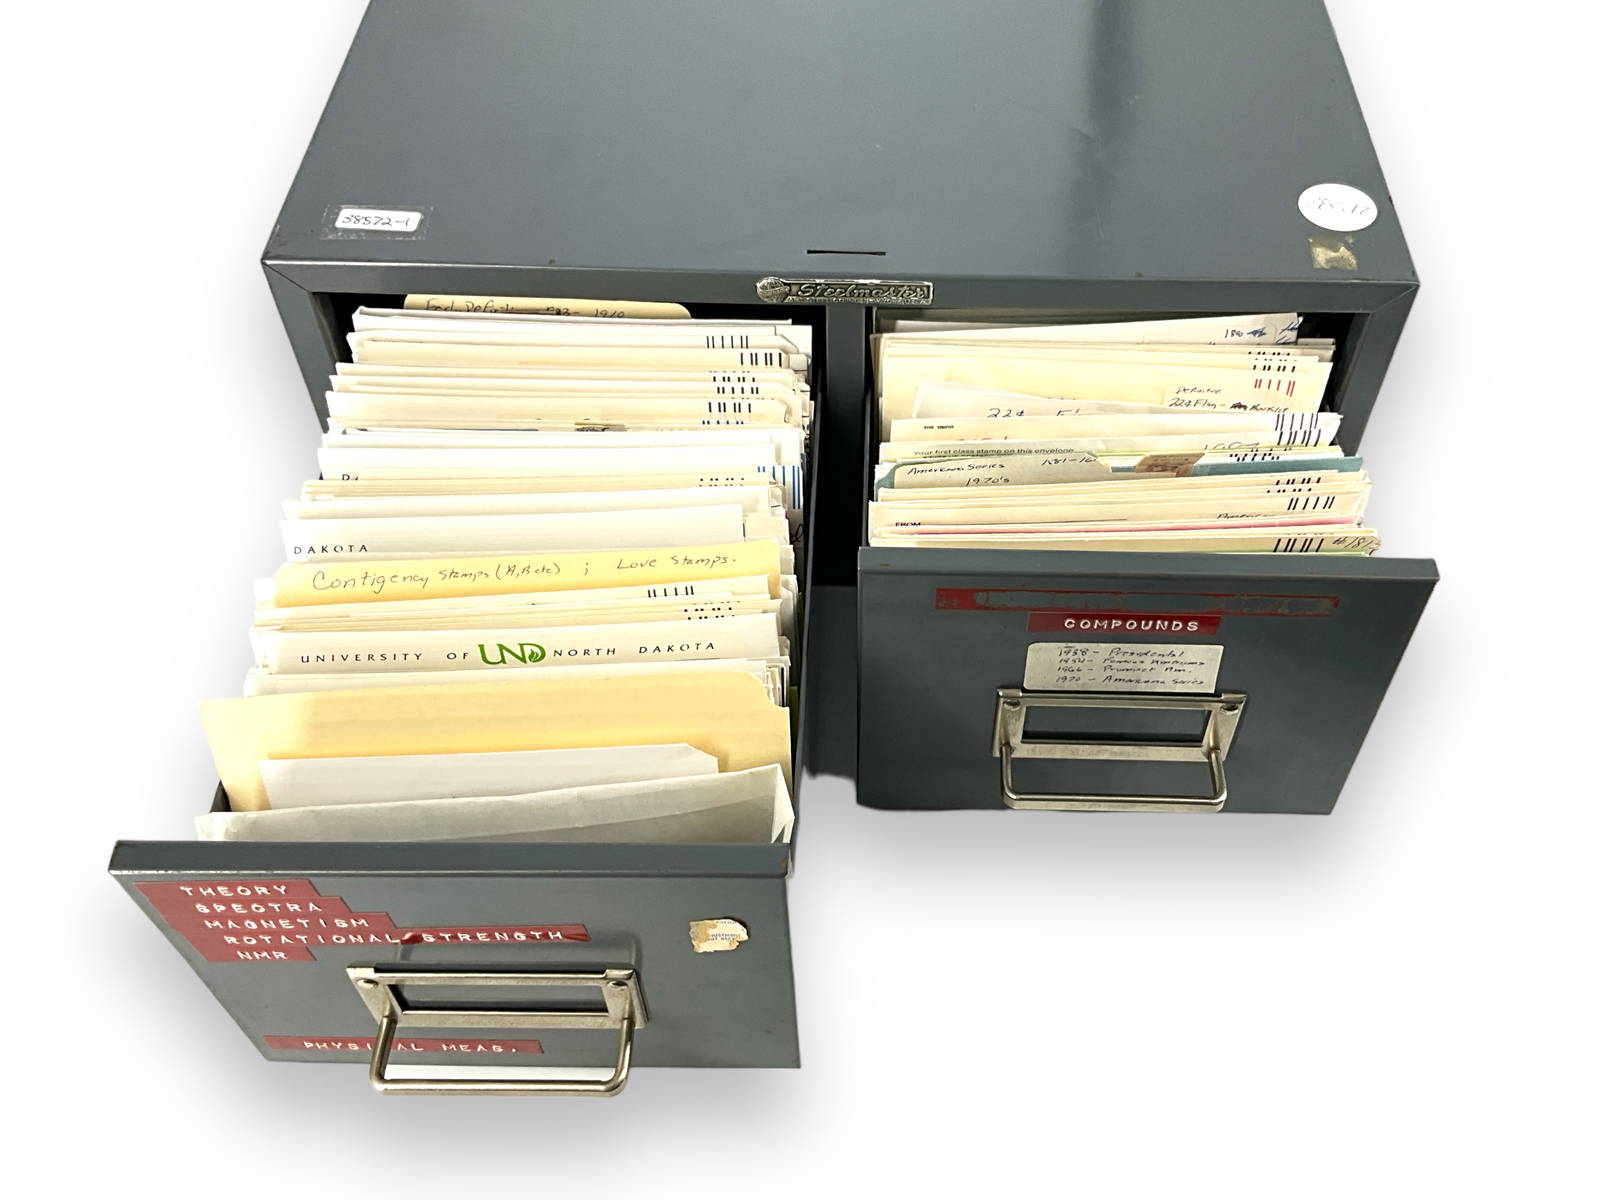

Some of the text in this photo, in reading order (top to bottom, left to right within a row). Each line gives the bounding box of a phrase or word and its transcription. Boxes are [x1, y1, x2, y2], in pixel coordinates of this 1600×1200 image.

[797, 283, 926, 298] Steelmaster
[293, 543, 368, 554] DAKOTA
[312, 570, 429, 594] Contigency
[617, 558, 656, 569] Love
[1064, 618, 1199, 632] COMPOUNDS
[301, 653, 422, 663] UNIVERSITY
[477, 643, 546, 665] UND
[553, 647, 616, 657] NORTH
[638, 642, 715, 654] DAKOTA
[180, 884, 288, 897] THEORY
[195, 902, 323, 914] SPECTRA
[204, 918, 369, 930] MAGNETISM
[224, 931, 564, 946] ROTATIONAL STRENGTH
[236, 950, 288, 961] NMR
[303, 1040, 518, 1054] PHYSIAL MEAS.
